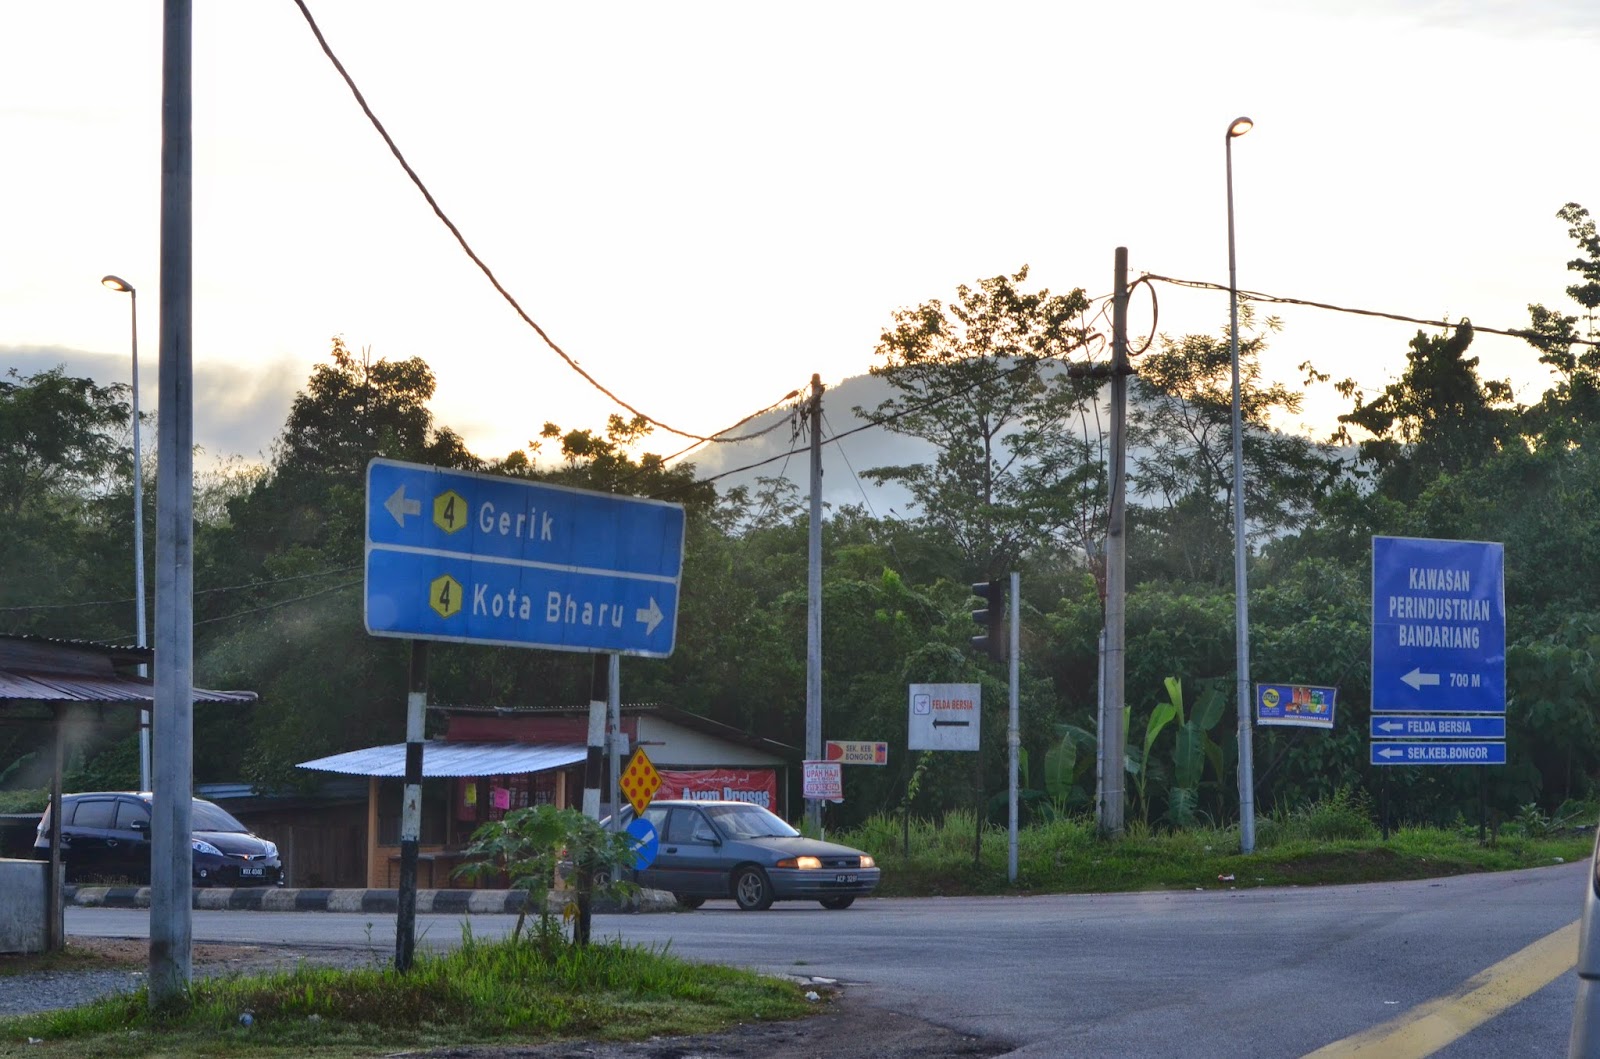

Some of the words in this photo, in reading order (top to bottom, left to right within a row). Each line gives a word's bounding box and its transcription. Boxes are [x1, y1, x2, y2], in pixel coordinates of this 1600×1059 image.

[443, 496, 455, 528] 4
[479, 501, 554, 542] Gerik
[1409, 567, 1470, 592] KAWASAN
[439, 580, 451, 612] 4
[473, 583, 531, 621] Kota
[546, 591, 623, 628] Bharu
[1389, 596, 1490, 622] PERINDUSTRIAN
[1399, 626, 1480, 650] BANDARIANG
[1450, 673, 1468, 688] 700
[1471, 674, 1480, 688] M
[932, 699, 950, 710] FELDA
[1408, 720, 1436, 733] FELDA
[1438, 720, 1472, 733] BERSIA
[846, 753, 873, 761] BONGOR
